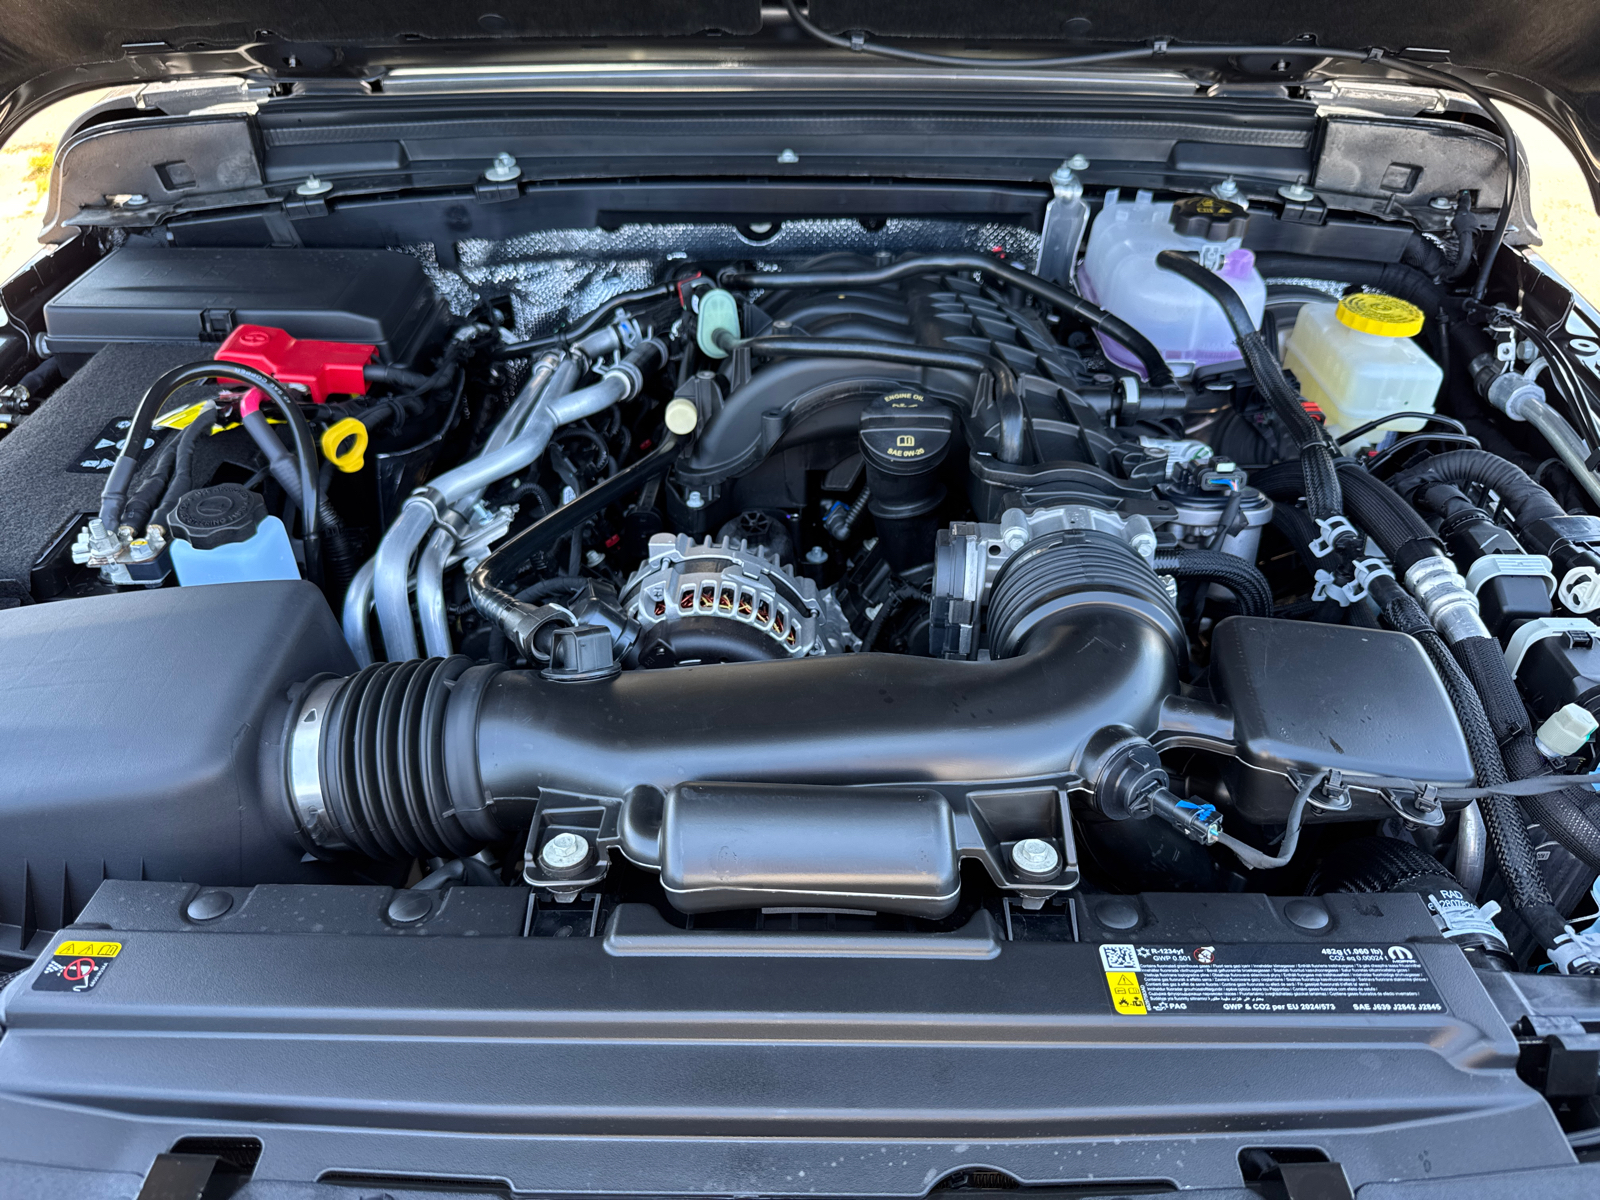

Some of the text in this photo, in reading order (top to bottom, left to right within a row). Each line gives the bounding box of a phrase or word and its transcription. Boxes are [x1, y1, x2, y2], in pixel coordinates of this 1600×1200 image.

[234, 367, 268, 383] COPPER
[884, 393, 925, 402] ENGINE OIL
[887, 448, 902, 457] SAE
[1440, 890, 1463, 899] RAD
[1321, 948, 1343, 956] 482g
[1370, 948, 1383, 956] lb)
